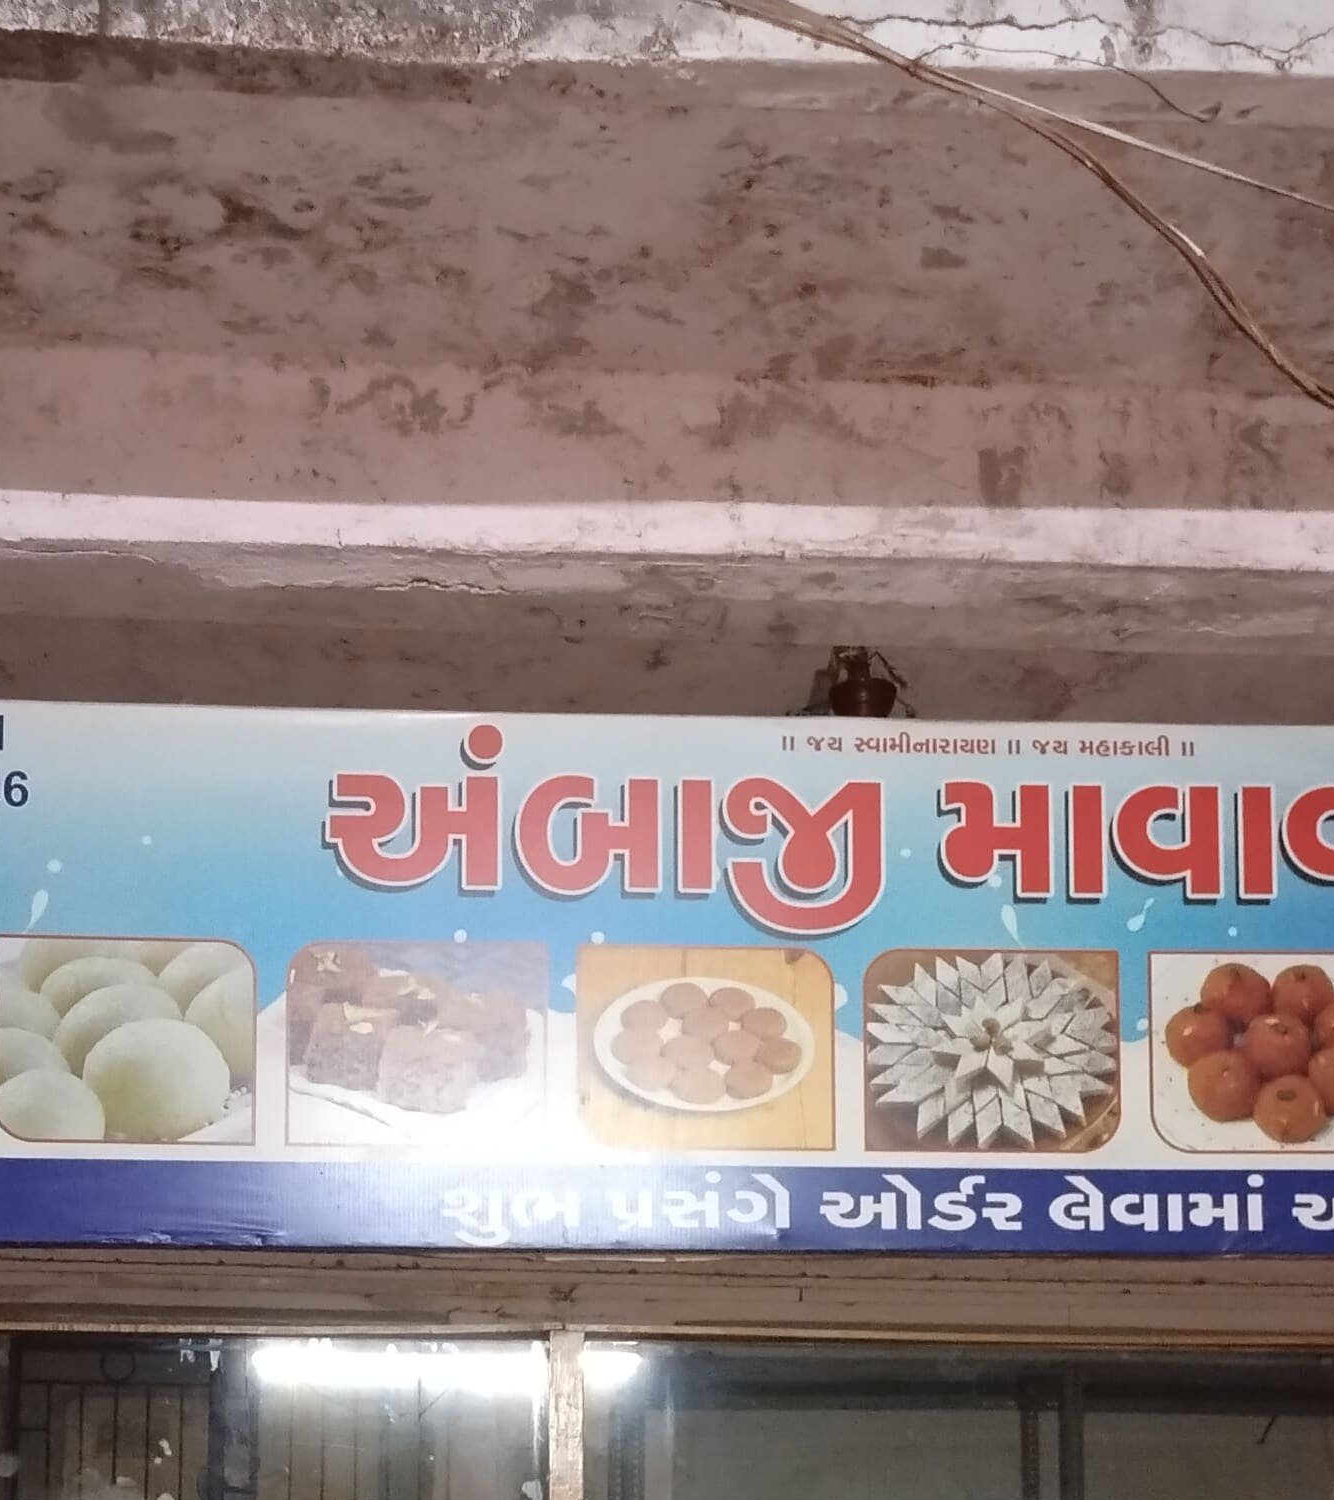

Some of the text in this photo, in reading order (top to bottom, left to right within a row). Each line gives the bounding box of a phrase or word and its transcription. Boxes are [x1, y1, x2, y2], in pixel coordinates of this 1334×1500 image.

[806, 735, 843, 752] જય
[853, 731, 997, 755] સ્વામીનારાયણ
[1031, 739, 1068, 756] જય
[1078, 735, 1170, 758] મહાકાલી
[323, 724, 886, 936] અંબાજી
[441, 1187, 581, 1247] શુભ
[819, 1174, 1023, 1232] ઓર્ડર
[1048, 1174, 1265, 1232] લેવામાં
